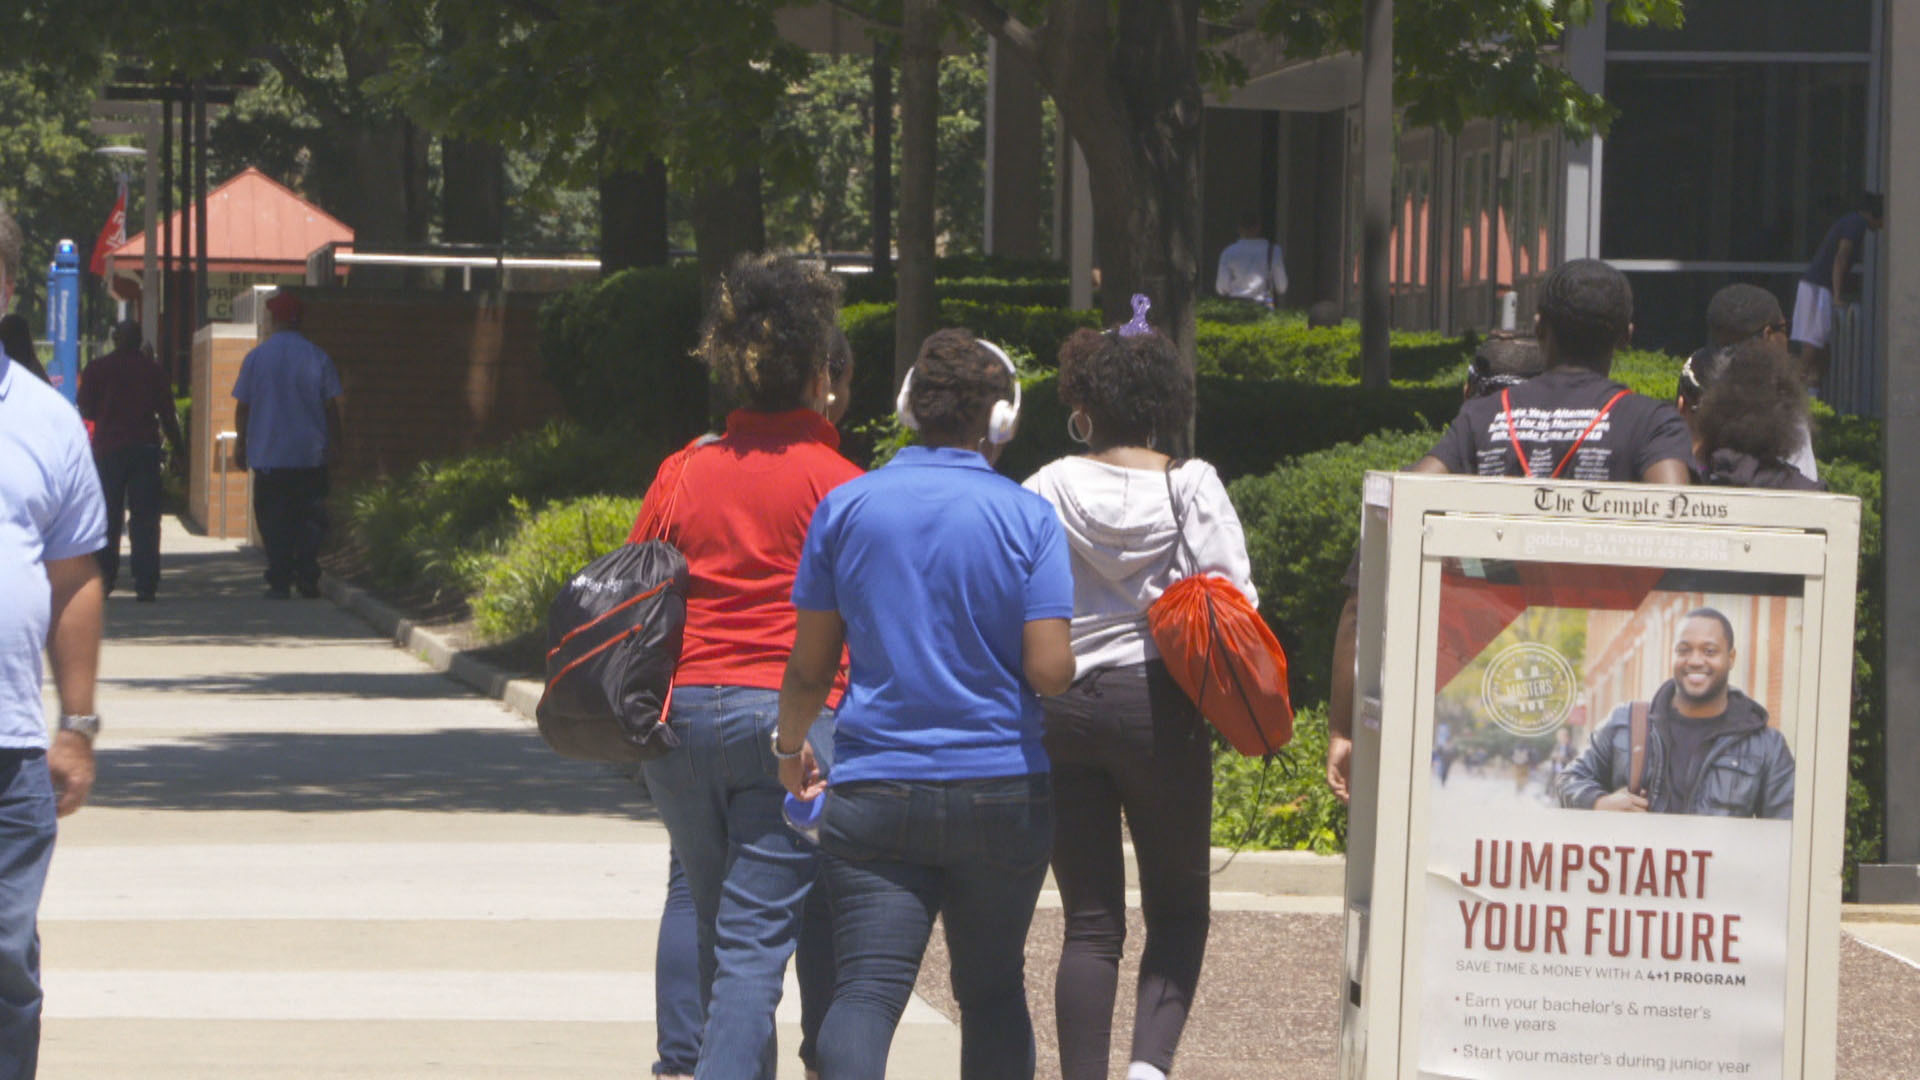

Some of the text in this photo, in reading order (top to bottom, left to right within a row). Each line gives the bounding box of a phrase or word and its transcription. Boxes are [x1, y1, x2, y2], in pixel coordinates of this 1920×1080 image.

[1534, 487, 1728, 518] The Temple News
[1460, 838, 1713, 900] JUMPSTART
[1458, 899, 1742, 965] YOUR FUTURE
[1456, 960, 1746, 987] SAVE TIME & MONEY WITH A 4+1 PROGRAM
[1465, 992, 1711, 1020] Earn your bachelor's & master's
[1464, 1014, 1557, 1032] in five years
[1463, 1043, 1751, 1075] Start your master's during junior year
